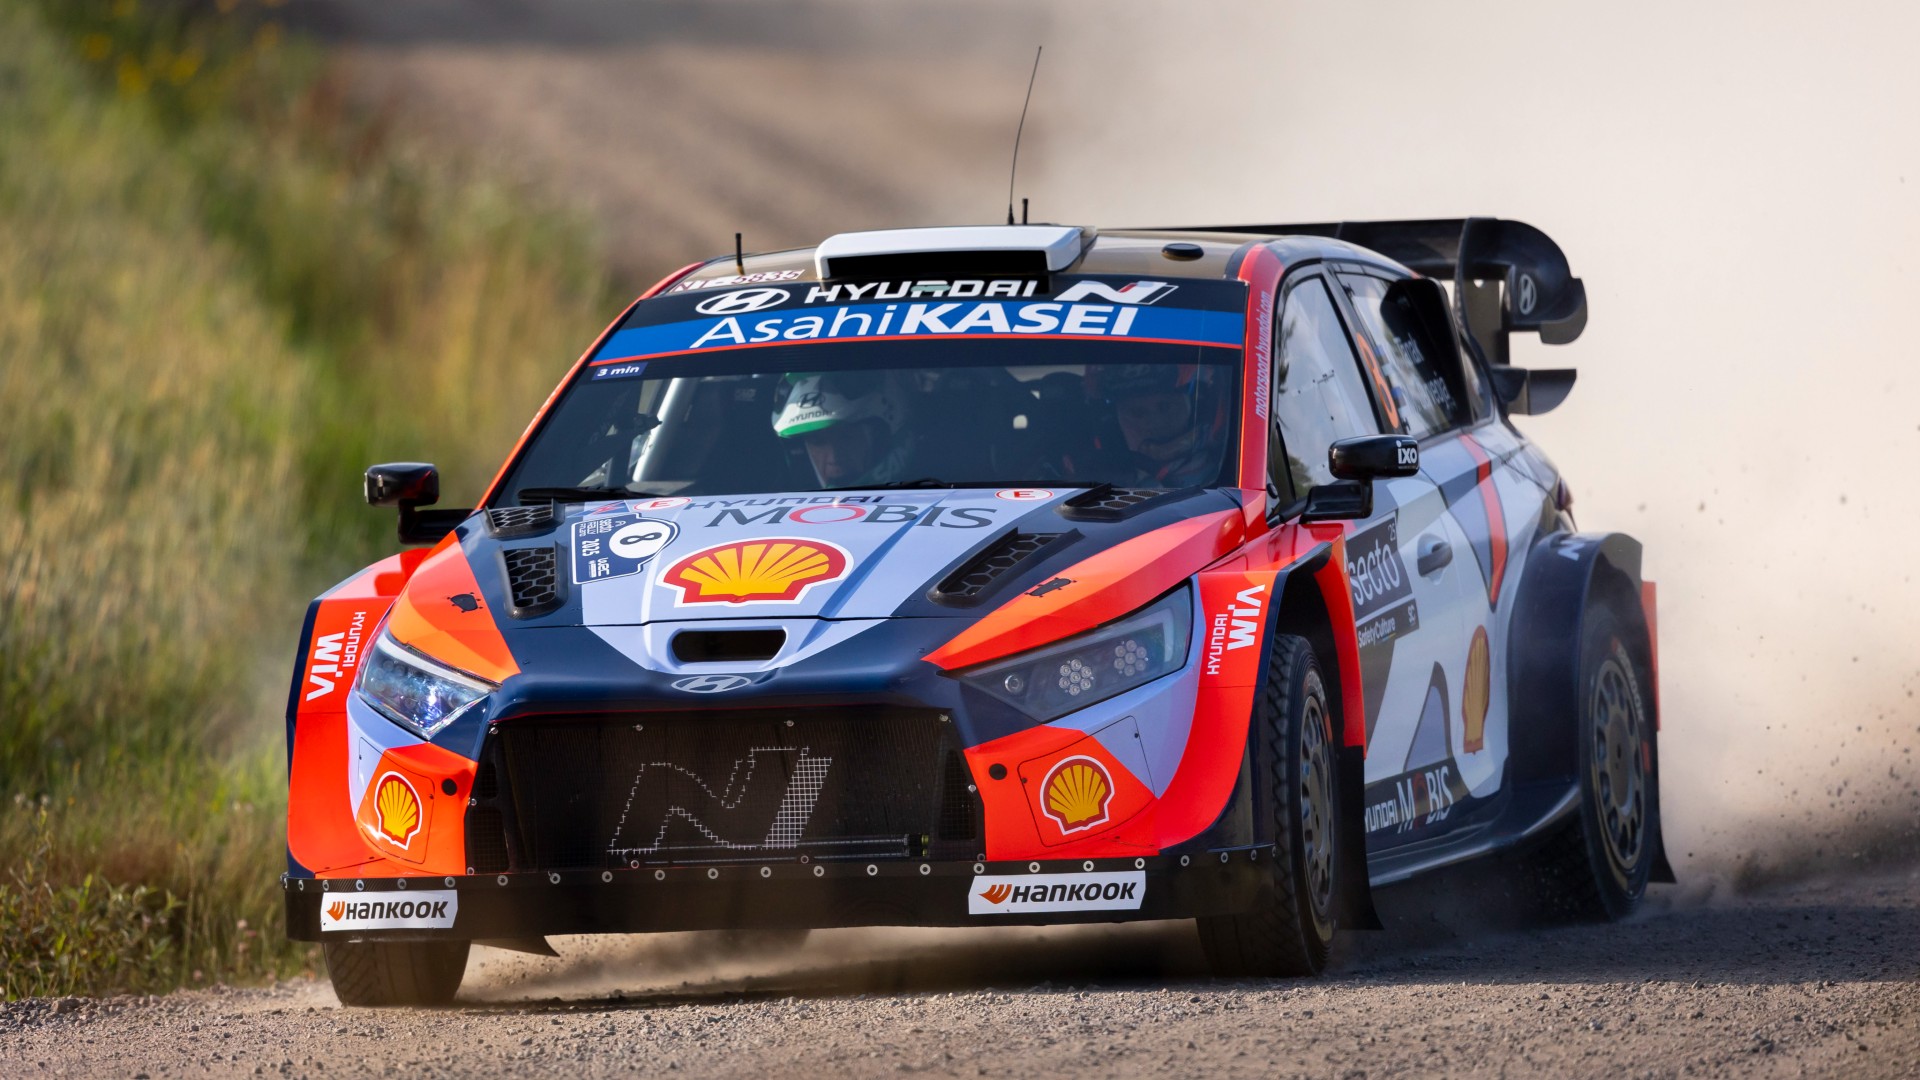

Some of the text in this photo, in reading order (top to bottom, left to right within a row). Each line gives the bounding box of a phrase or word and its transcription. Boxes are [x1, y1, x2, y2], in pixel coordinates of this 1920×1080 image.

[804, 280, 1038, 304] HYUNDAI
[1255, 290, 1272, 420] motorsport.hyundai.com
[597, 365, 640, 377] 3 min
[649, 500, 674, 508] E
[684, 496, 887, 511] HYUNDAI
[1013, 490, 1036, 498] E
[705, 504, 998, 529] MOBIS
[582, 538, 600, 557] 2025
[619, 532, 663, 545] 8
[1348, 539, 1400, 606] secto
[342, 611, 367, 668] HYUNDAI
[1206, 613, 1229, 675] HYUNDAI
[1364, 798, 1399, 833] YUNDAI
